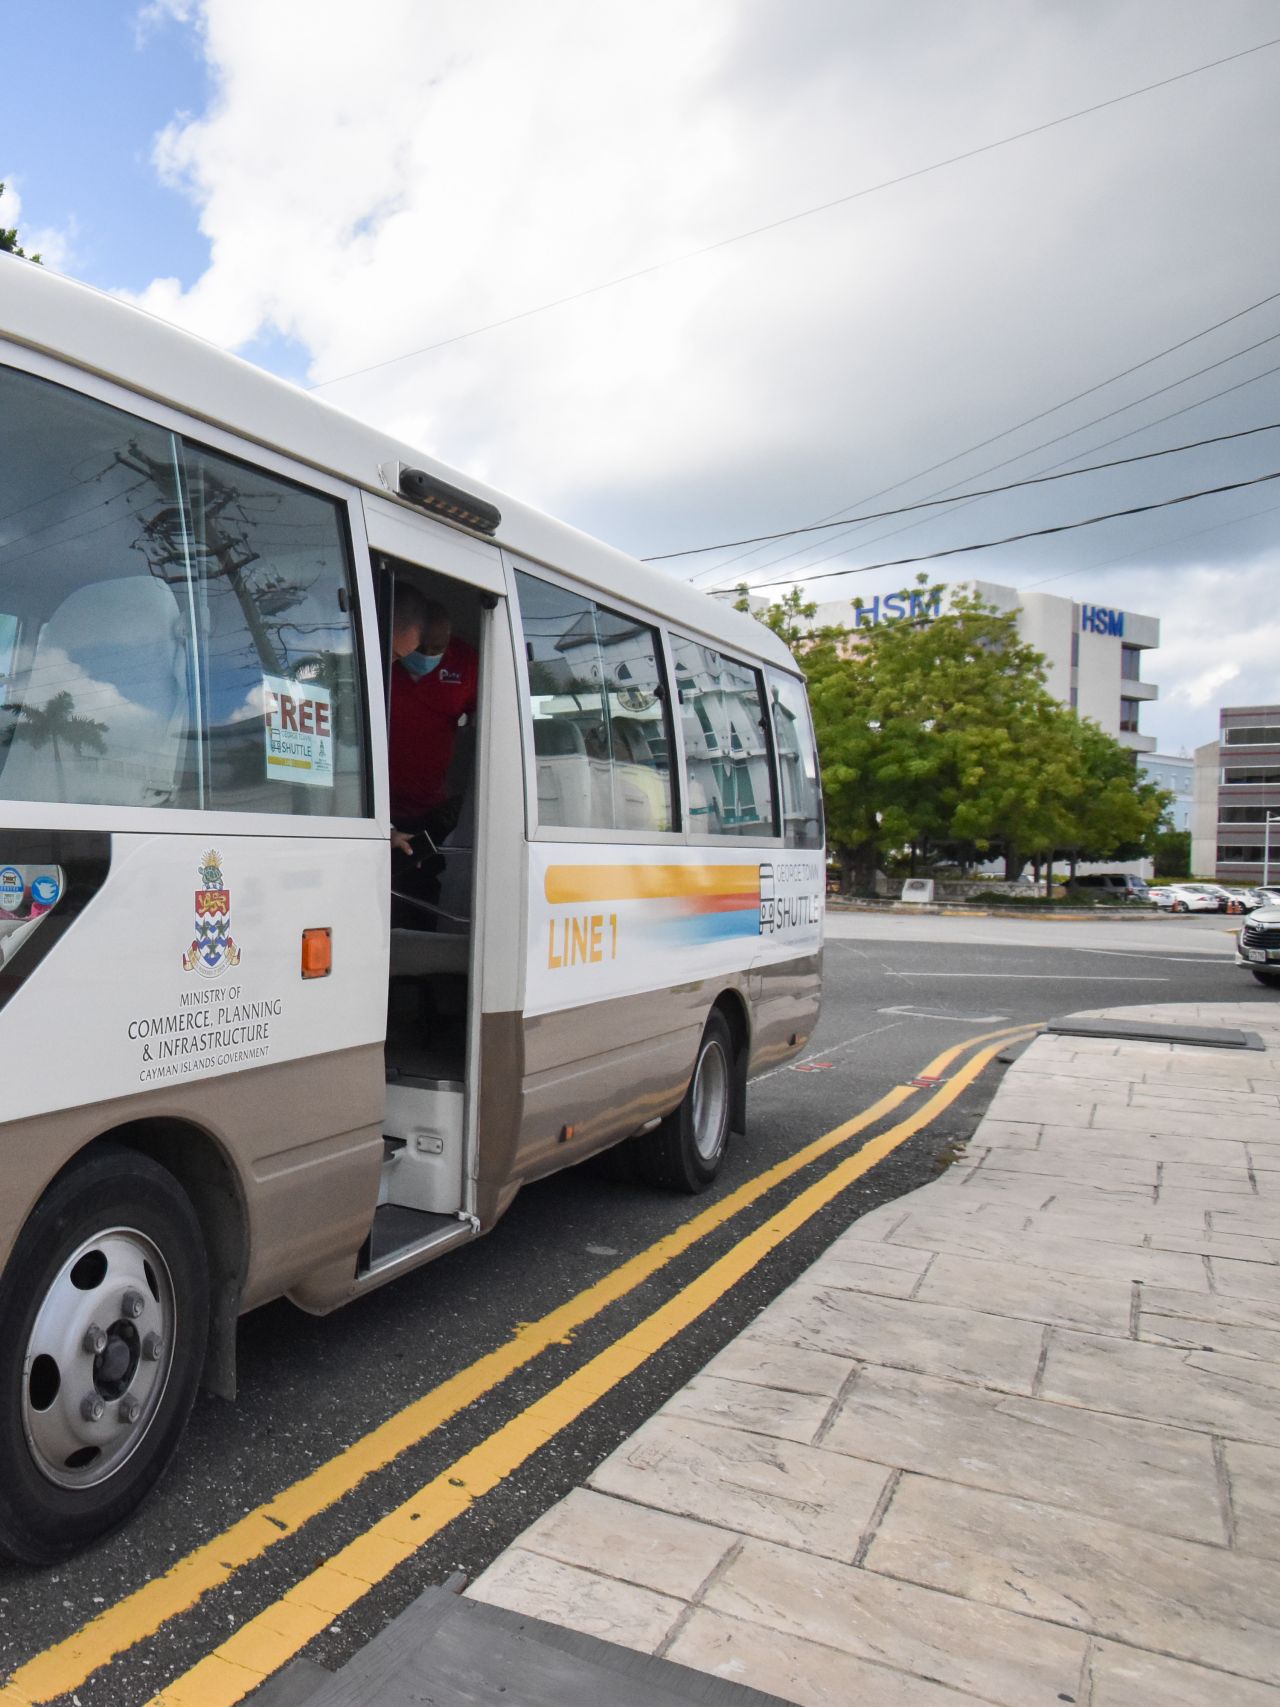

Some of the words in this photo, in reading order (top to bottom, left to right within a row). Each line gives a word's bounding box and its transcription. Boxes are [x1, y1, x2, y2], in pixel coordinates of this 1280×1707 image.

[855, 588, 941, 627] HSM
[1082, 604, 1124, 637] HSM
[265, 691, 330, 738] FREE
[282, 741, 312, 757] SHUTTLE
[777, 895, 818, 929] SHUTTLE
[548, 914, 603, 969] LINE
[610, 913, 617, 960] 1
[179, 988, 226, 1007] MINISTRY
[228, 986, 241, 1000] OF
[128, 1010, 214, 1040] COMMERCE,
[218, 999, 282, 1025] PLANNING
[142, 1043, 153, 1062] &
[158, 1022, 269, 1059] INFRASTRUCTURE
[139, 1063, 178, 1081] CAYMAN
[181, 1056, 215, 1073] ISLANDS
[217, 1045, 269, 1066] GOVERNMENT
